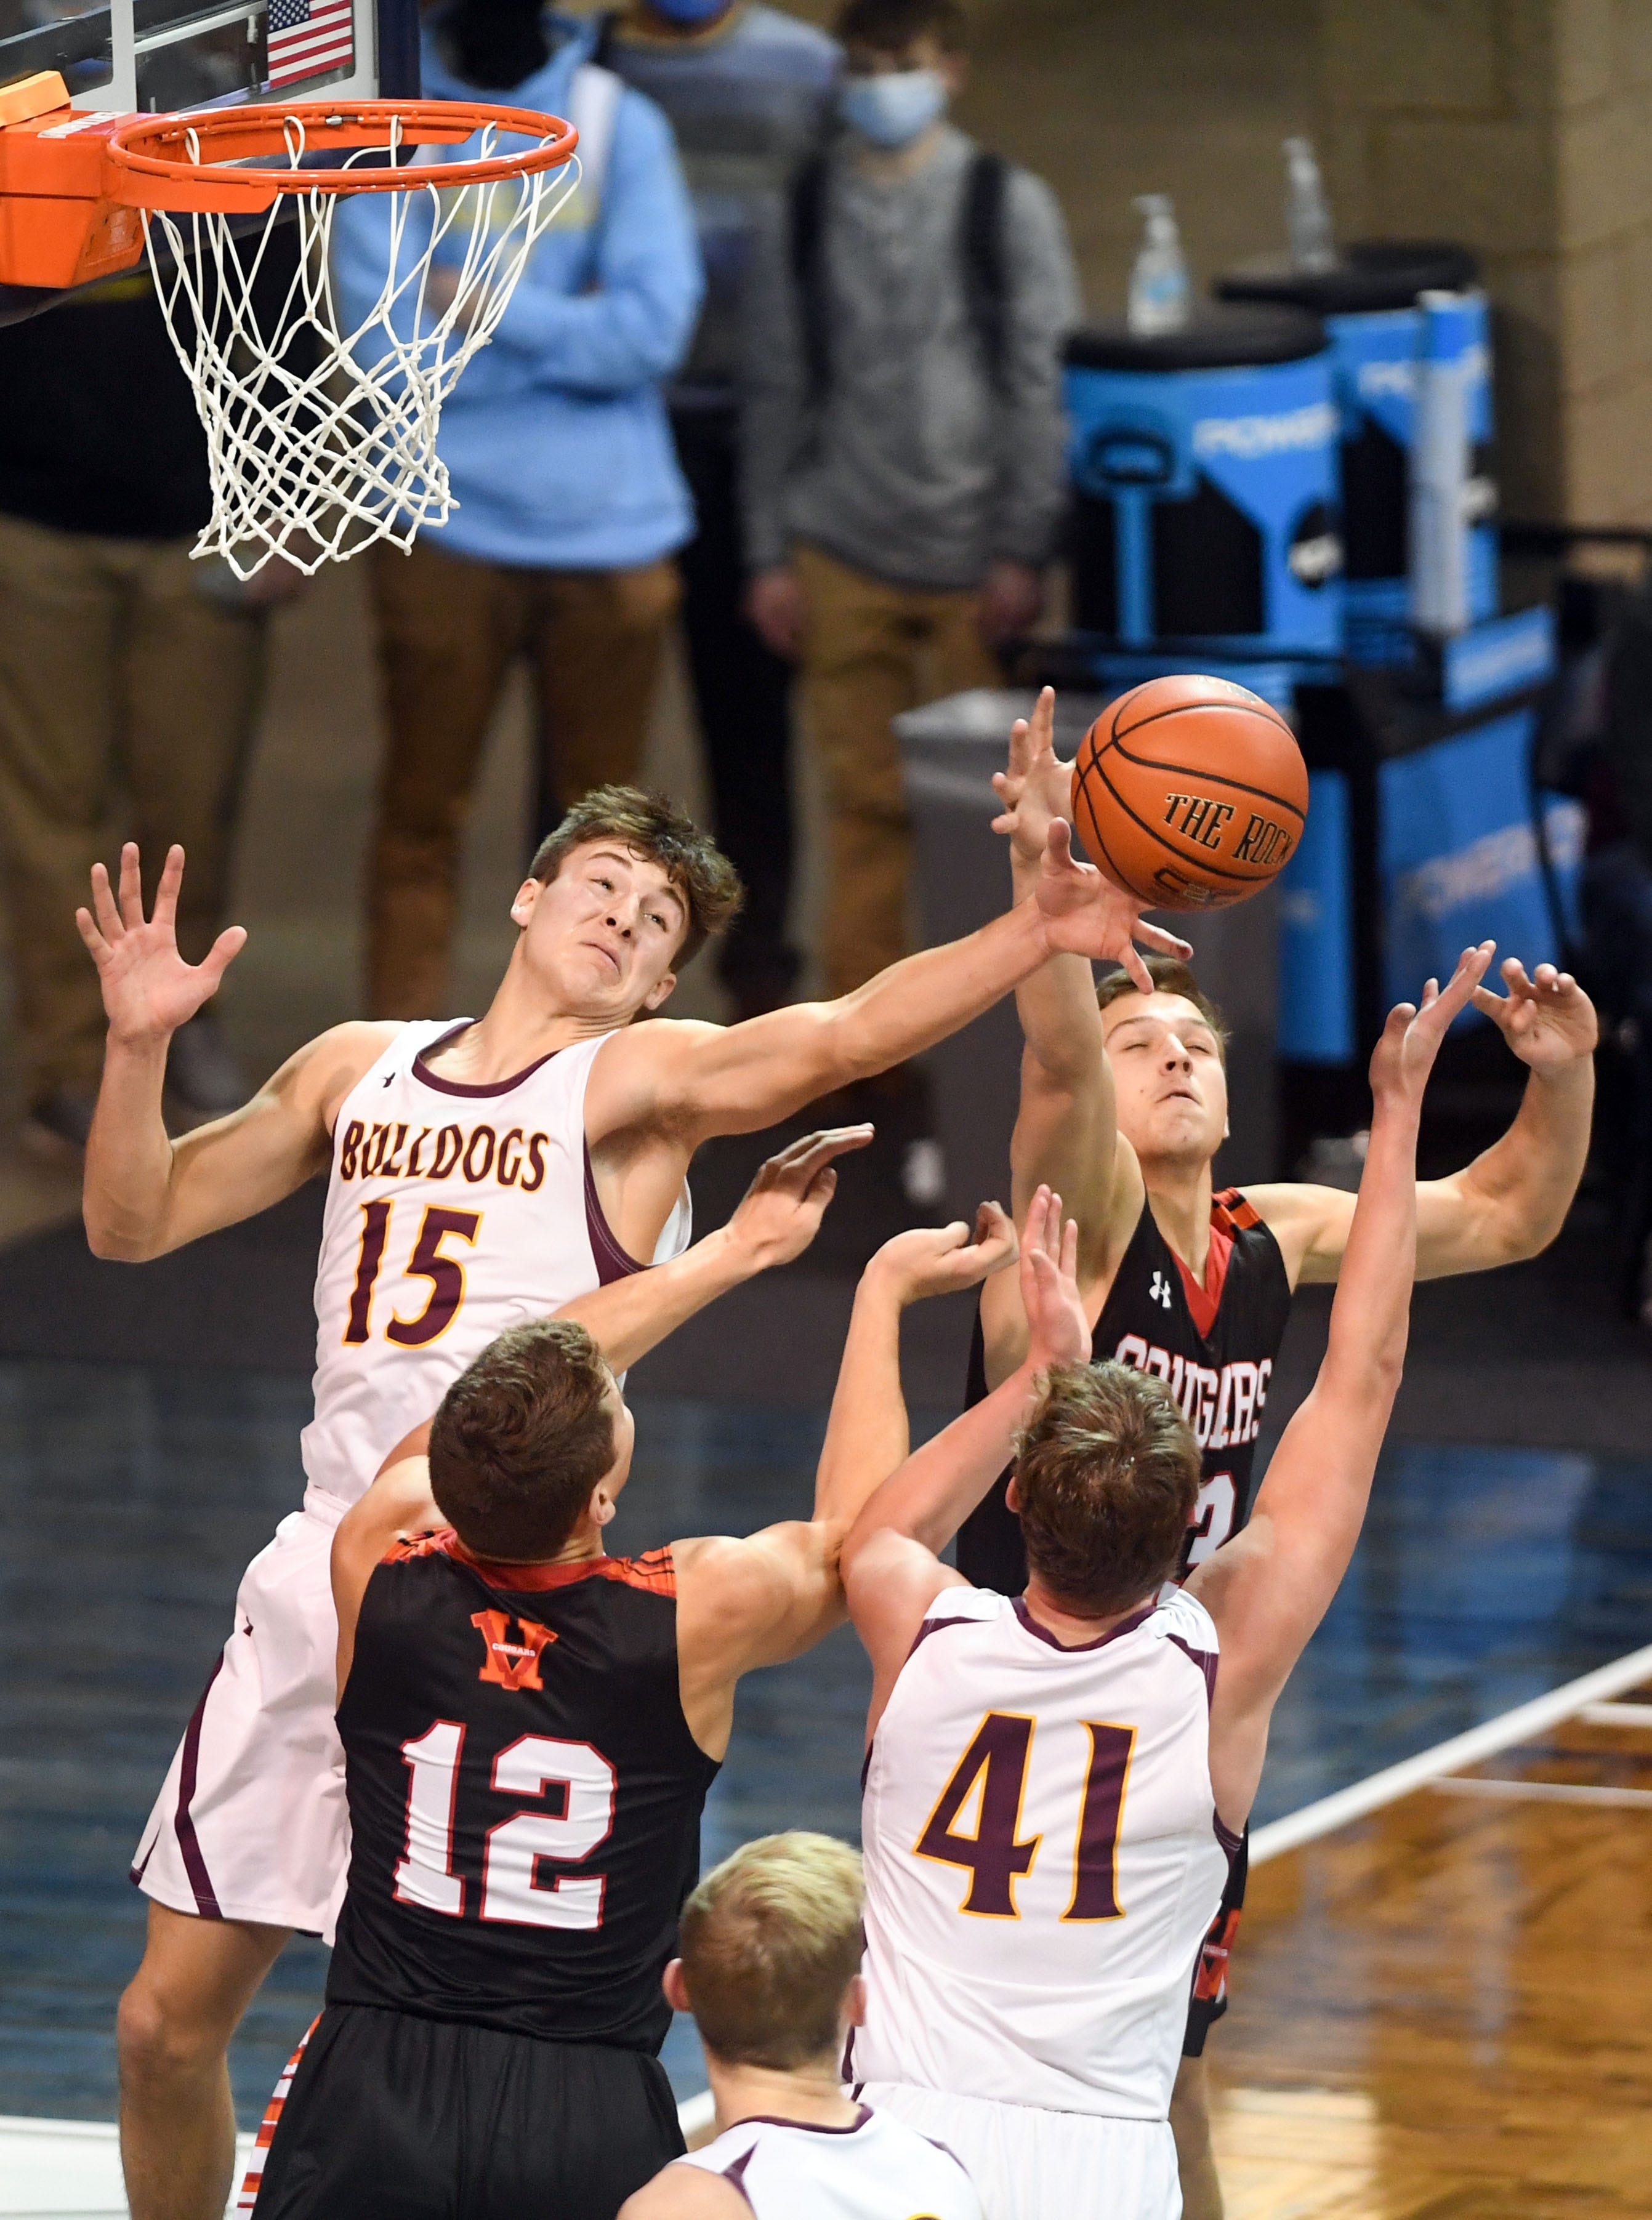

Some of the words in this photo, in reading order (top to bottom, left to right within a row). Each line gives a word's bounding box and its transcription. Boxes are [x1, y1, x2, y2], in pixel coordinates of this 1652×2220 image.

[1162, 792, 1236, 850] THE
[1231, 812, 1294, 864] ROCK
[340, 1119, 549, 1193] BULLDOGS
[341, 1198, 485, 1349] 15
[492, 1643, 536, 1657] COUGARS
[392, 1718, 618, 1932] 12
[911, 1709, 1138, 1923] 41
